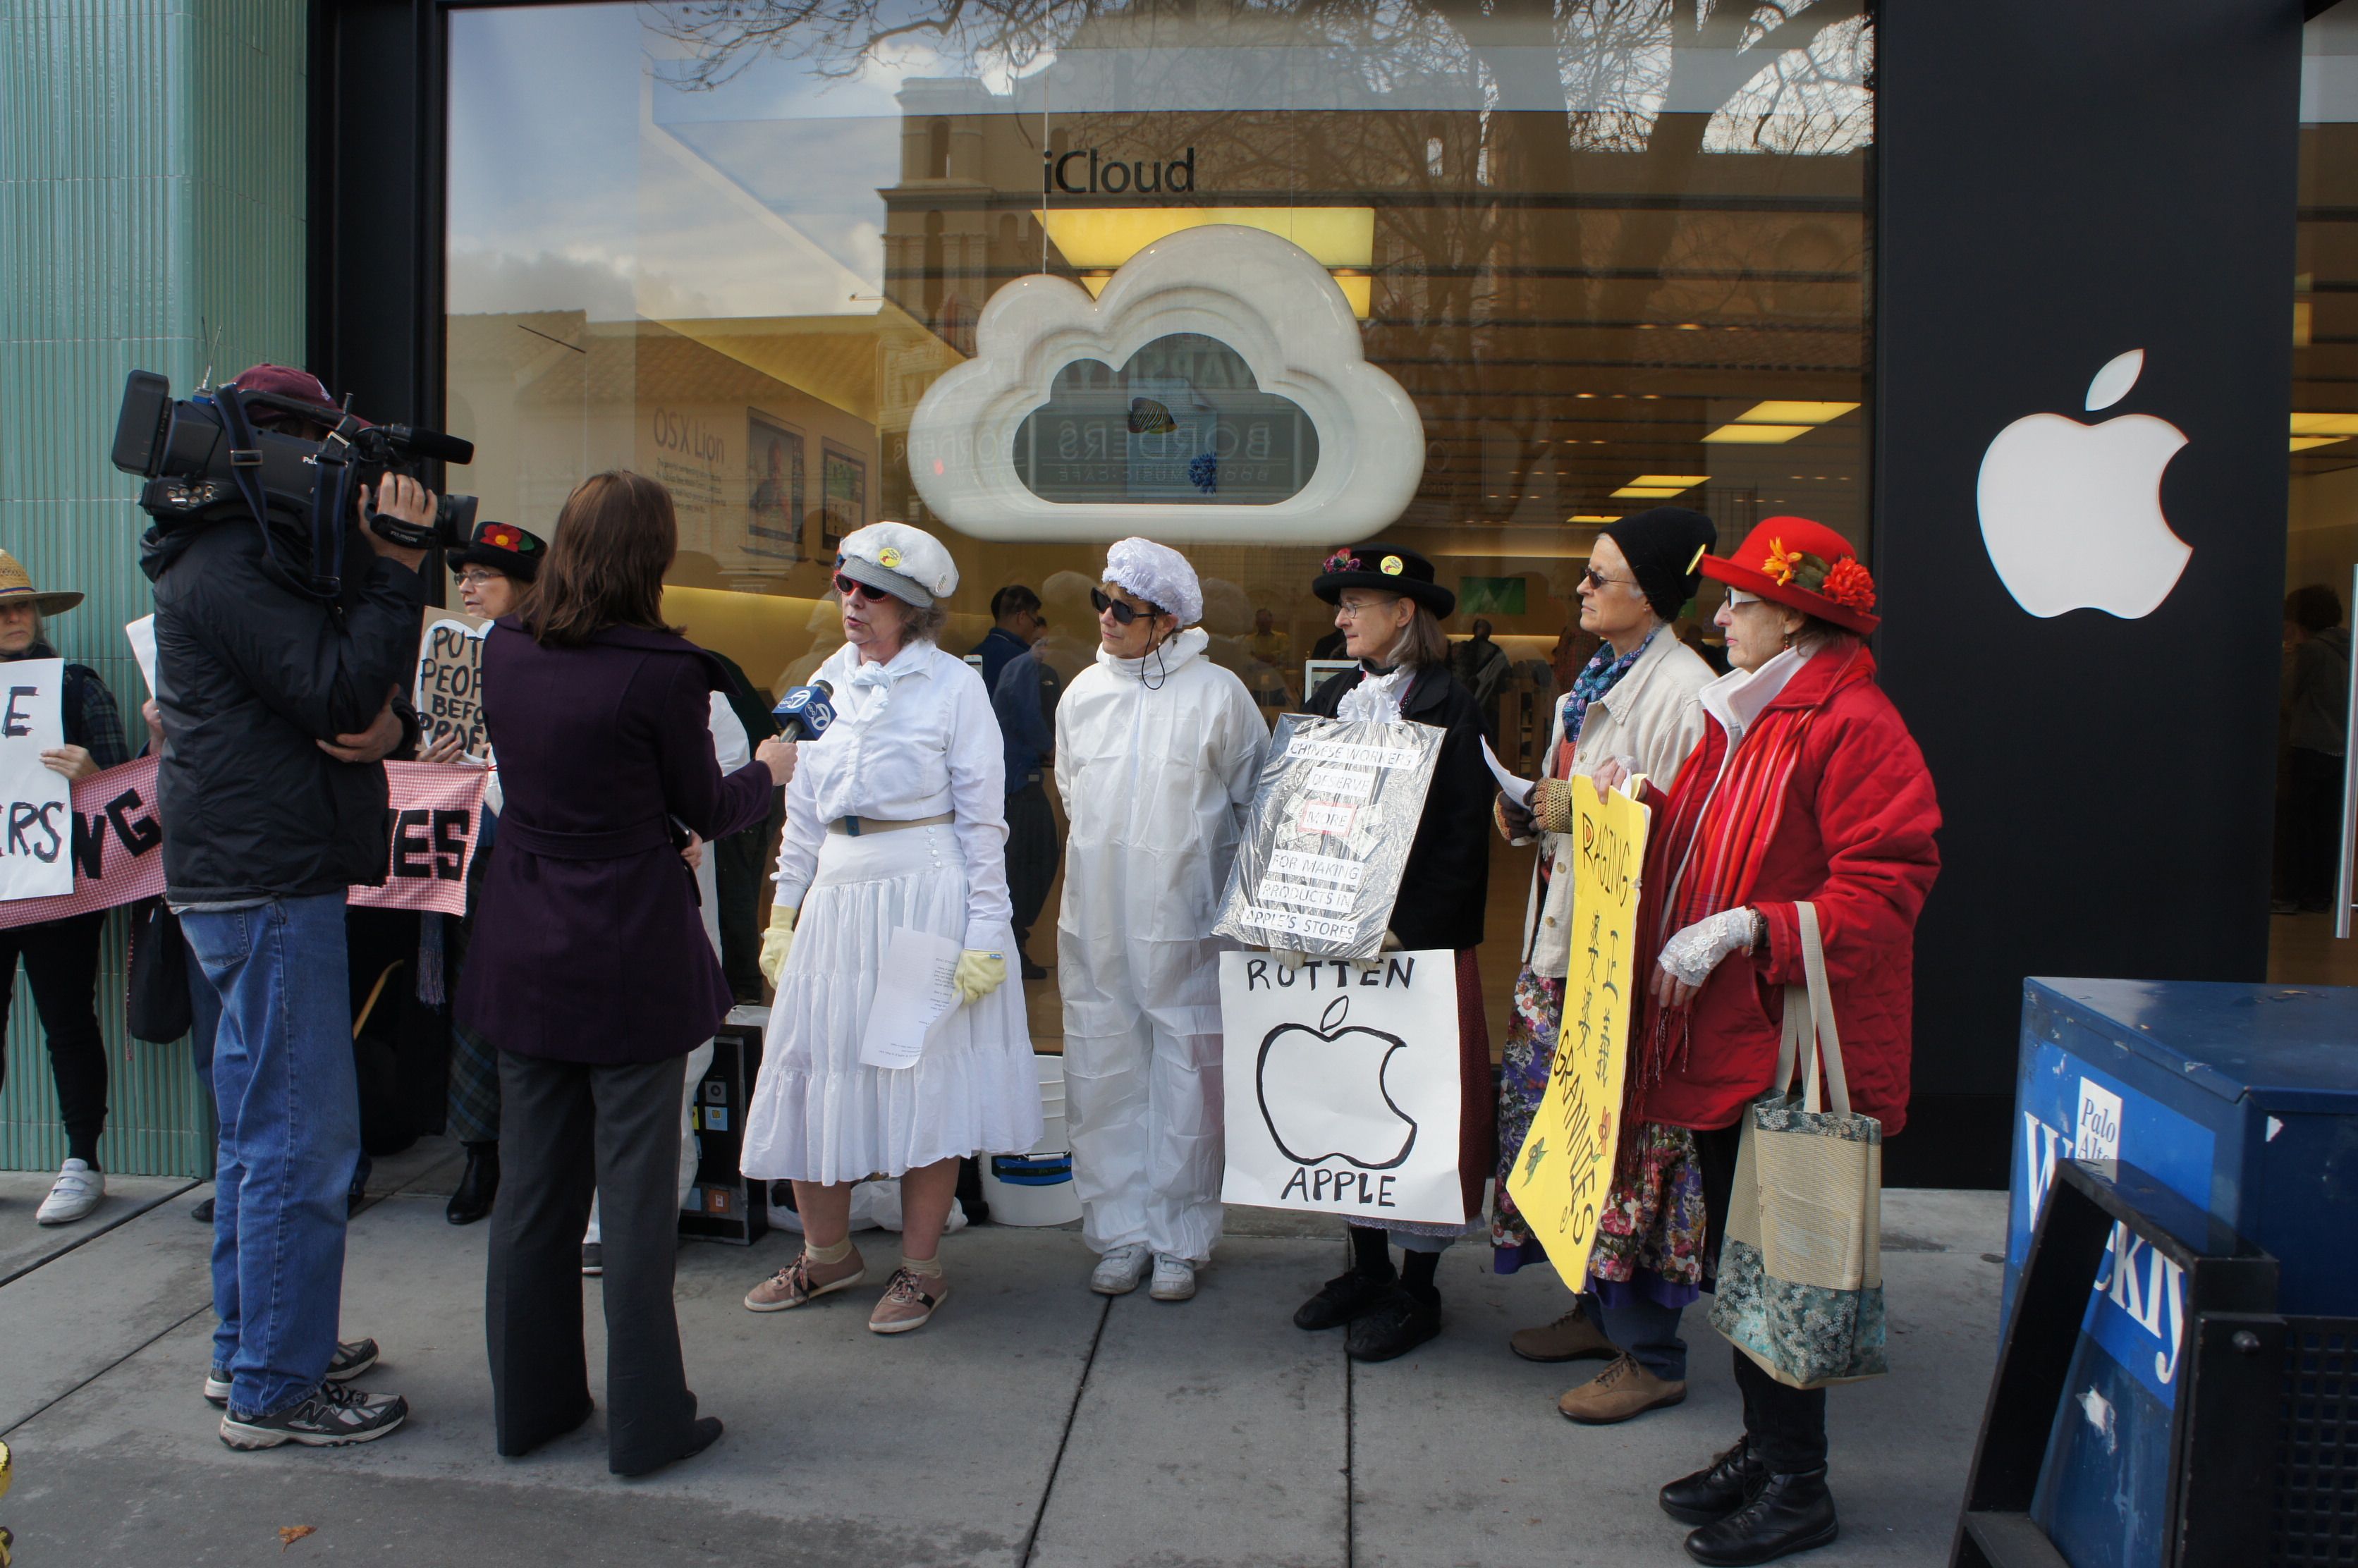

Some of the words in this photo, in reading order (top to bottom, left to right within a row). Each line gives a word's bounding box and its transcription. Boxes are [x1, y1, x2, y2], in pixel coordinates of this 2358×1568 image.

[1044, 147, 1195, 194] iCloud
[694, 419, 725, 465] Lion
[432, 626, 484, 668] PUT
[1290, 742, 1343, 760] CHINESE
[1346, 747, 1412, 766] WORKERS
[1312, 773, 1369, 793] DESERVE
[1305, 810, 1348, 828] MORE
[1273, 852, 1298, 869] FOR
[1302, 859, 1360, 879] MAKING
[1582, 812, 1630, 907] RAGING
[1263, 883, 1333, 906] PRODUCTS
[1337, 893, 1351, 908] IN
[1245, 908, 1297, 929] APPLE'S
[1302, 919, 1355, 940] STORES
[1247, 957, 1415, 991] ROTTEN
[1553, 1029, 1596, 1246] GRANNIES
[2080, 1096, 2116, 1144] Palo
[1281, 1167, 1397, 1208] APPLE
